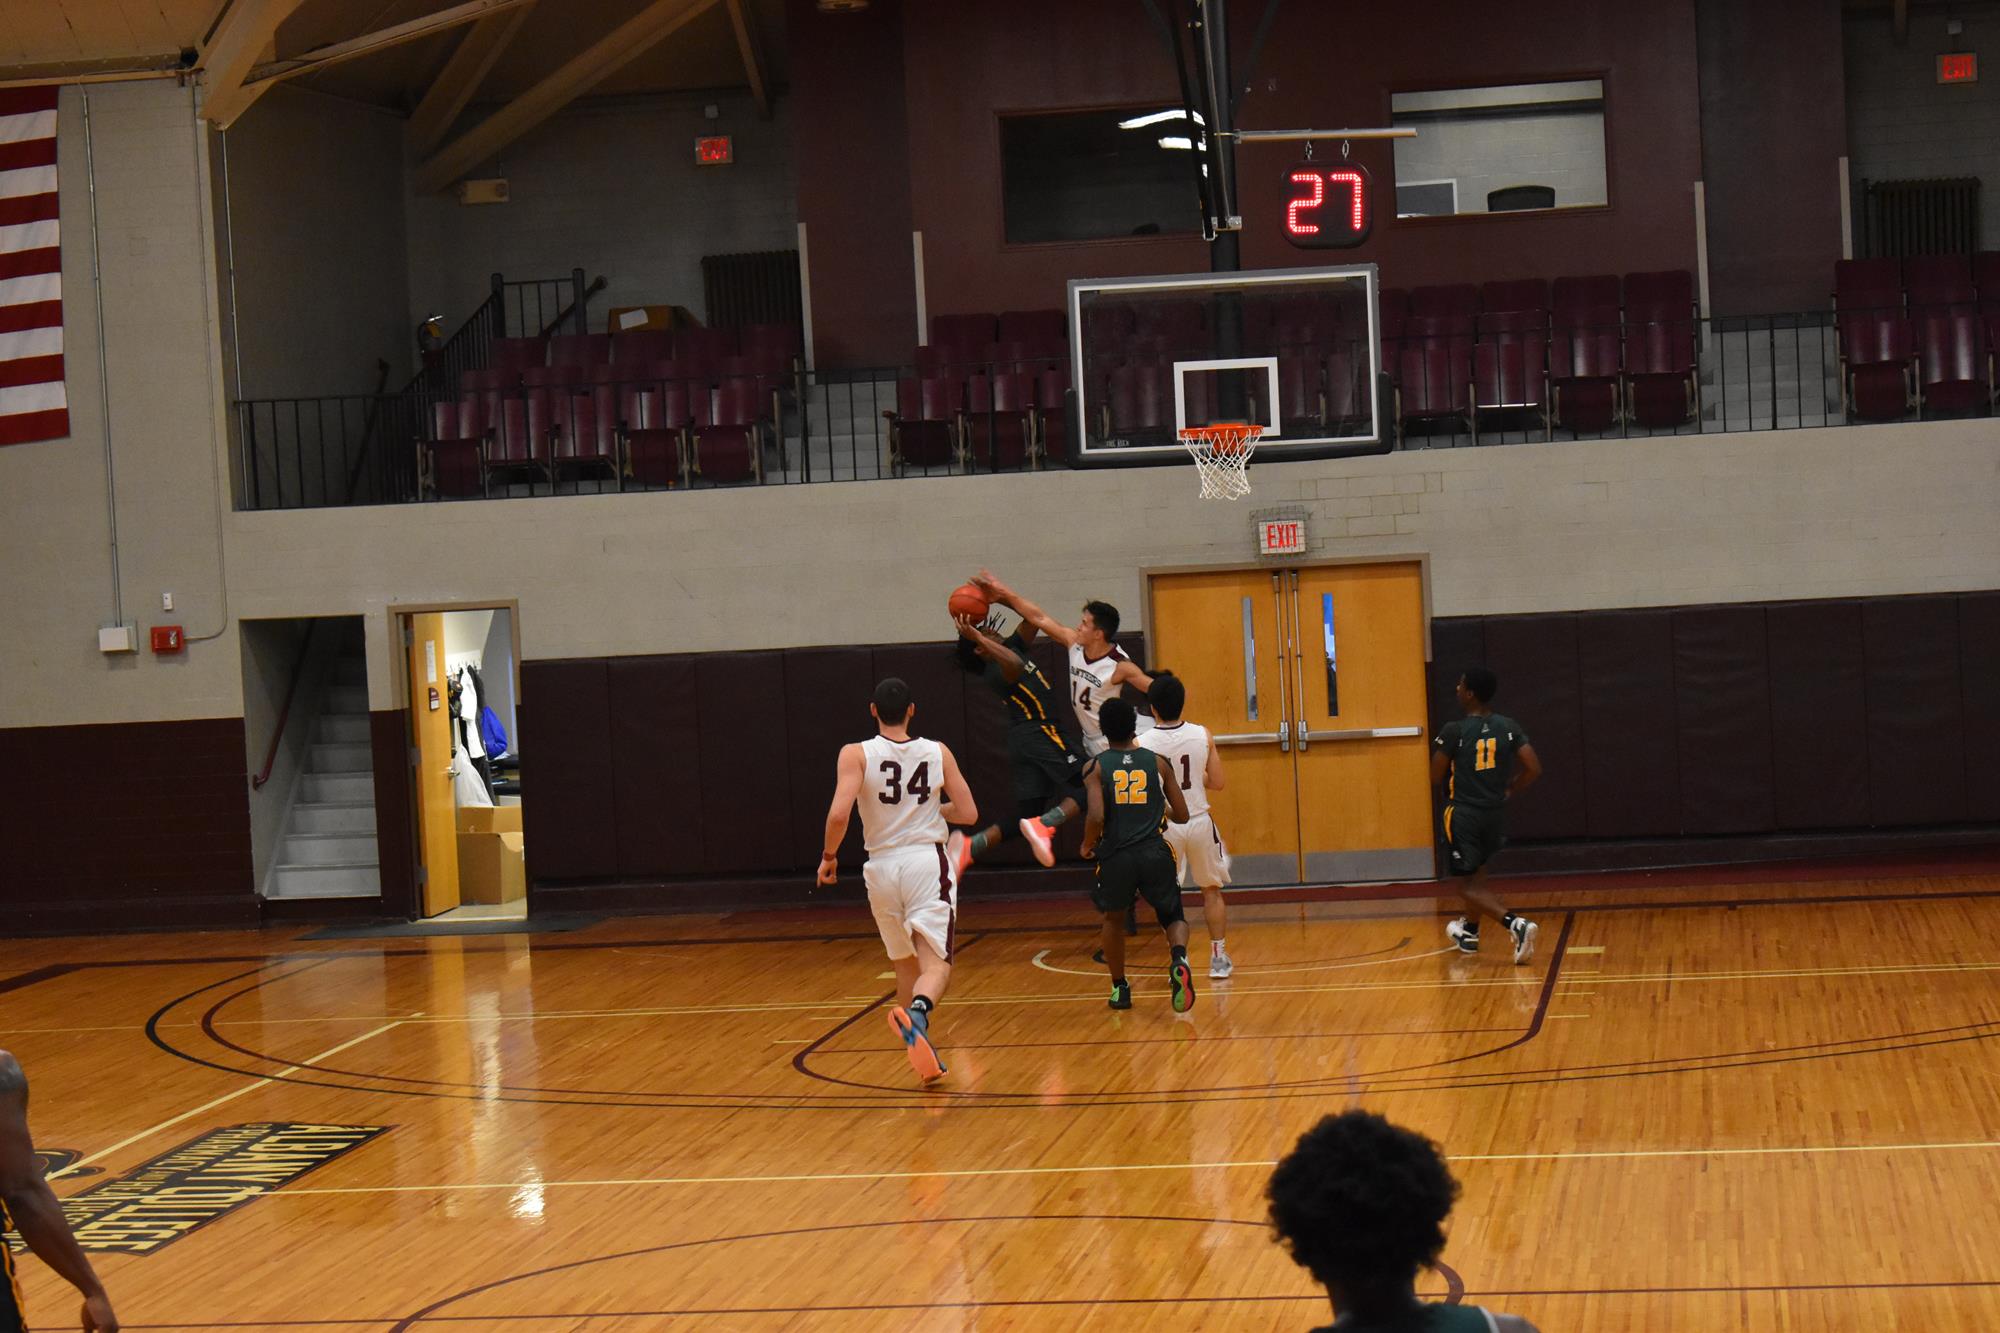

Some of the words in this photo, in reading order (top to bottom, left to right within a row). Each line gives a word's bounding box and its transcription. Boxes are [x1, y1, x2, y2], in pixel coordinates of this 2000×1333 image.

[1289, 173, 1362, 233] 27
[1266, 523, 1297, 549] EXIT
[1072, 680, 1092, 711] 14
[1475, 737, 1497, 771] 11
[878, 760, 931, 805] 34
[1113, 769, 1148, 805] 22
[185, 1123, 382, 1183] ALBANY
[72, 1185, 267, 1251] COLLEGE
